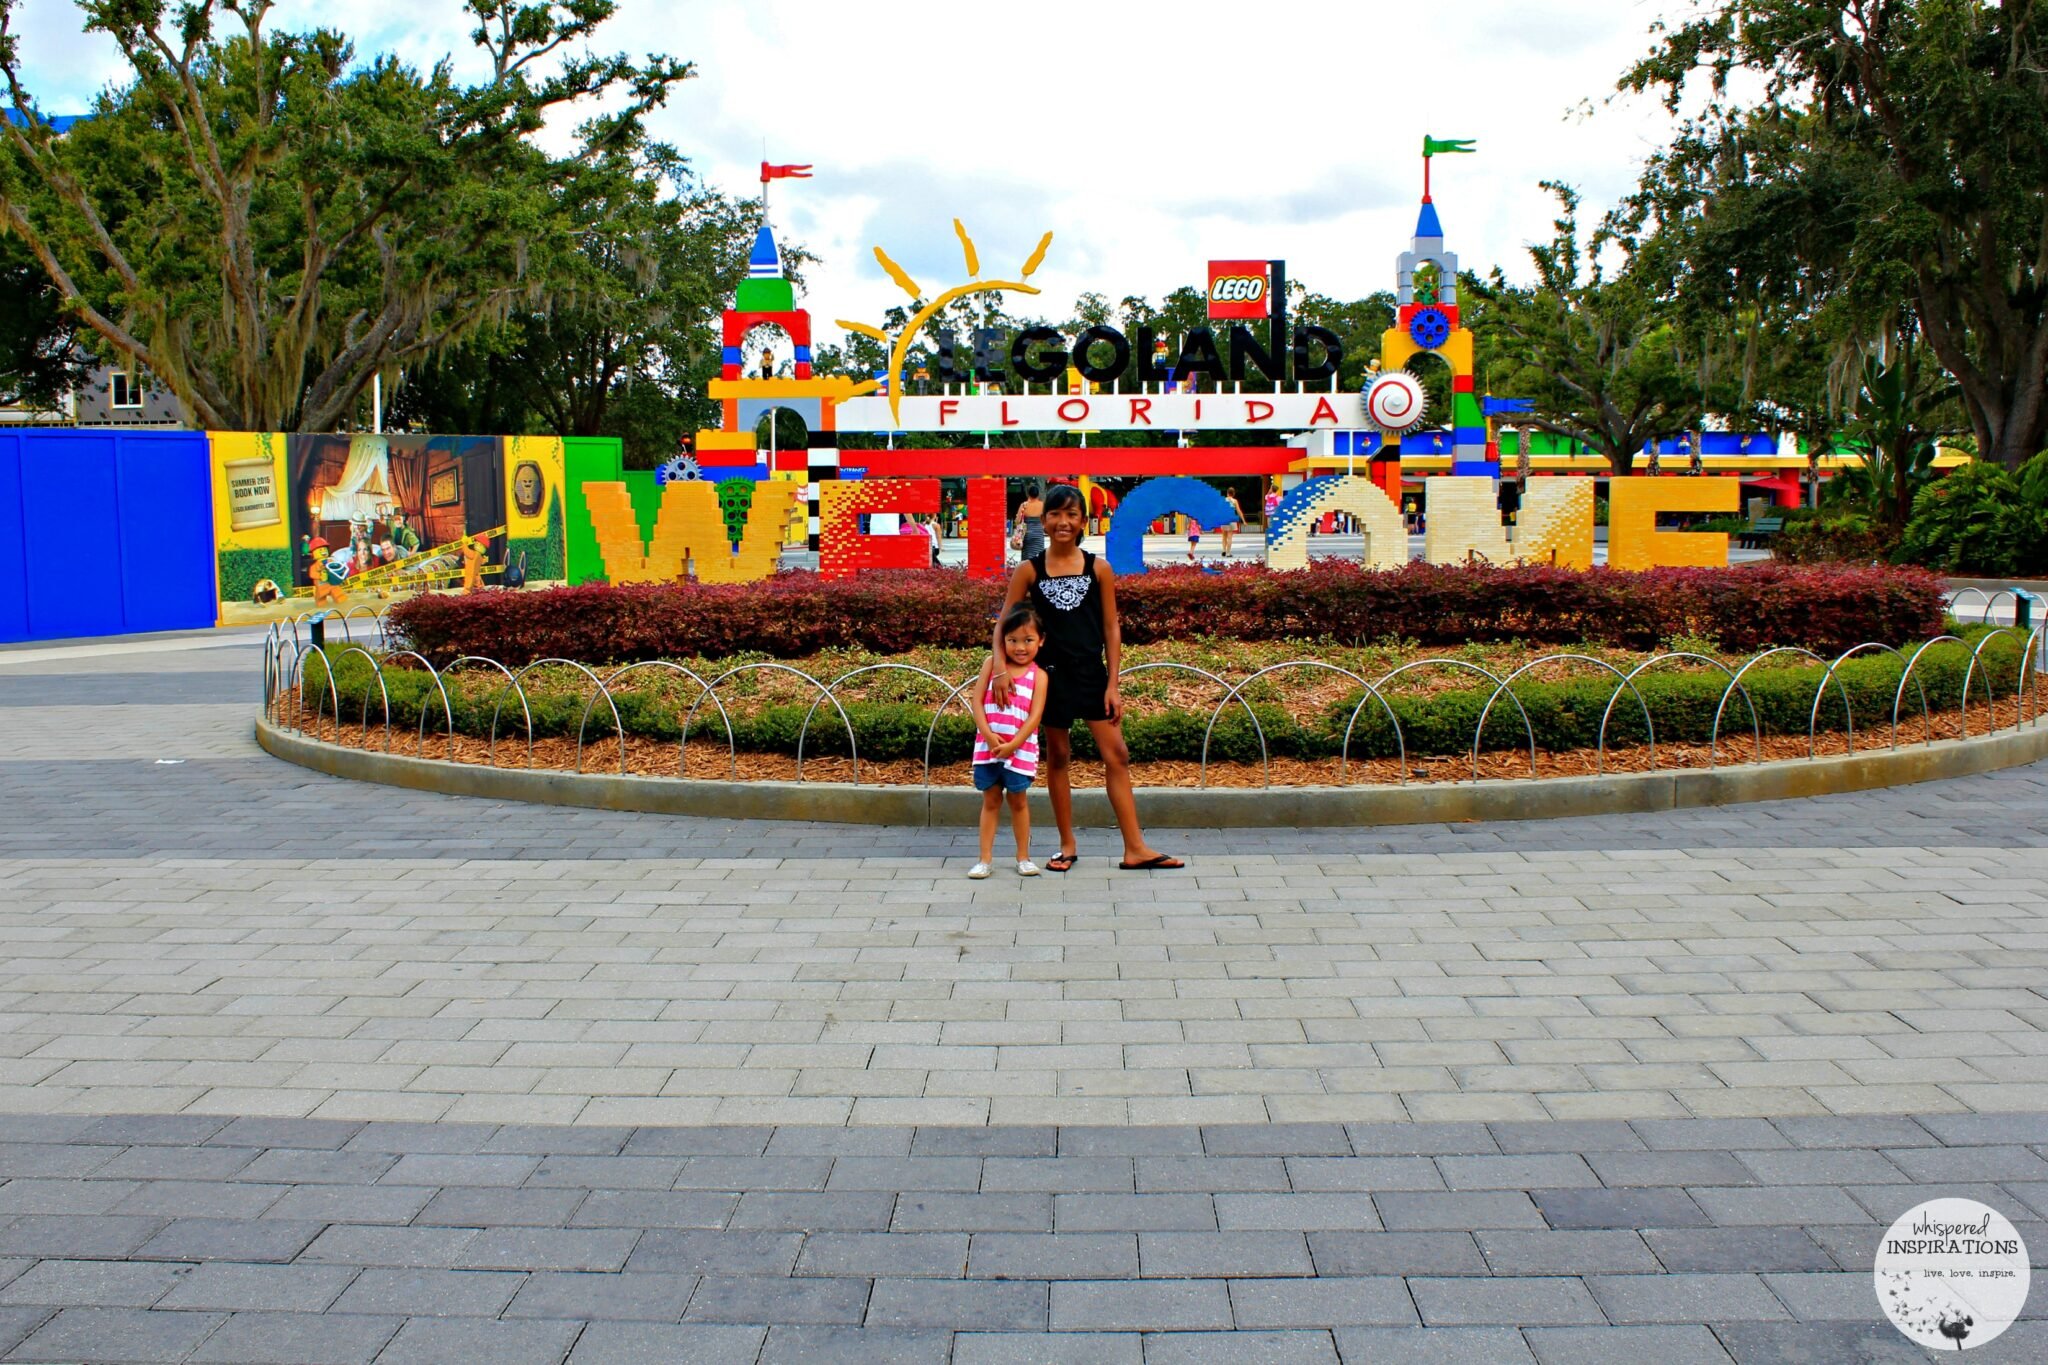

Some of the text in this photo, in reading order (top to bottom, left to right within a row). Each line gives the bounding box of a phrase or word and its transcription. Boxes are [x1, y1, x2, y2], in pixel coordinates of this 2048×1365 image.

[1211, 277, 1264, 302] LEGO
[938, 326, 1343, 384] LEGOLAND
[939, 397, 1339, 427] FLORIDA
[231, 476, 271, 488] SUMMER 2015
[234, 486, 270, 498] BOOK NOW
